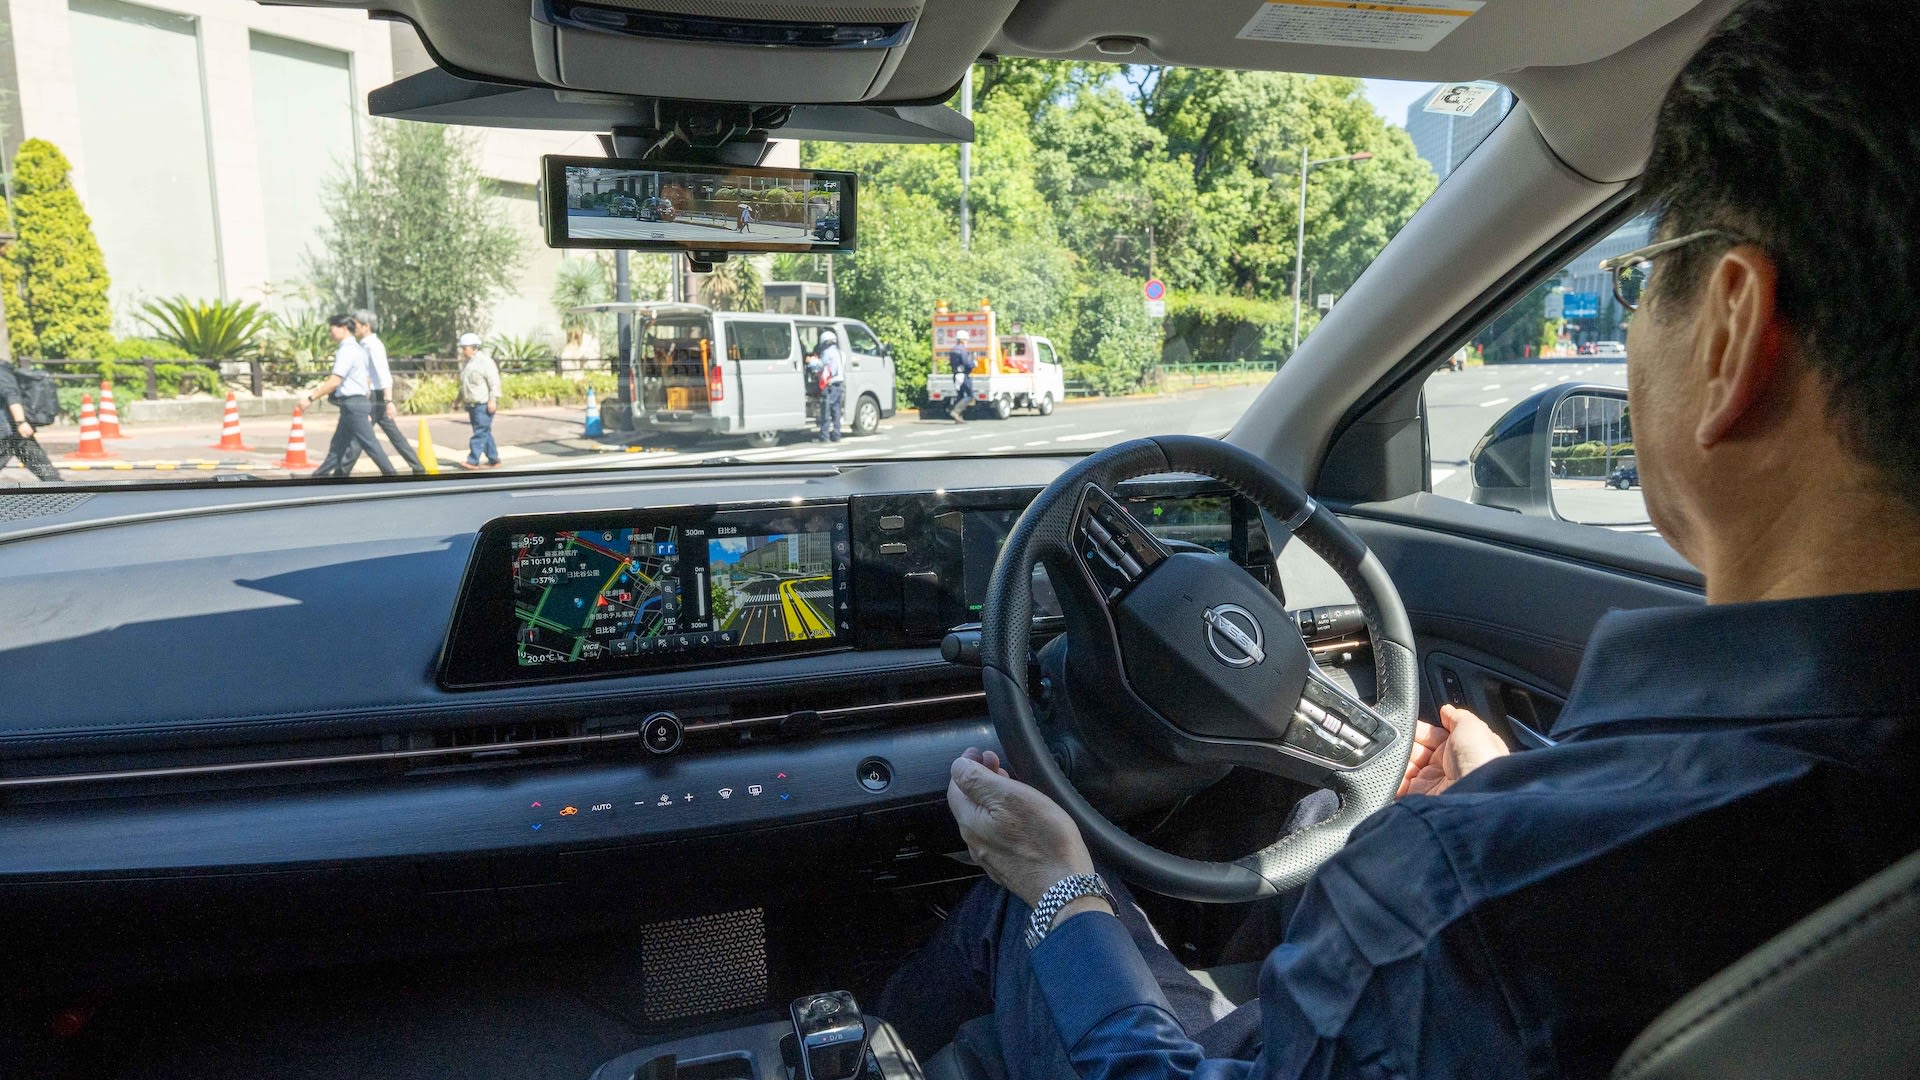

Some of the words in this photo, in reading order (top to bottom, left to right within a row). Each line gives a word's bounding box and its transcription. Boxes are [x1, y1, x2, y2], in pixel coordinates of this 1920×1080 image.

[718, 526, 737, 535] 日比谷
[523, 536, 545, 545] 9:59
[531, 558, 551, 566] 10:19
[541, 566, 553, 574] 4.9
[567, 569, 600, 578] 日比谷公園
[538, 576, 556, 584] 37%
[690, 621, 708, 629] 300m
[595, 626, 616, 635] 日比谷
[1203, 609, 1264, 661] NISSAN
[582, 643, 600, 651] VICS
[591, 803, 612, 812] AUTO
